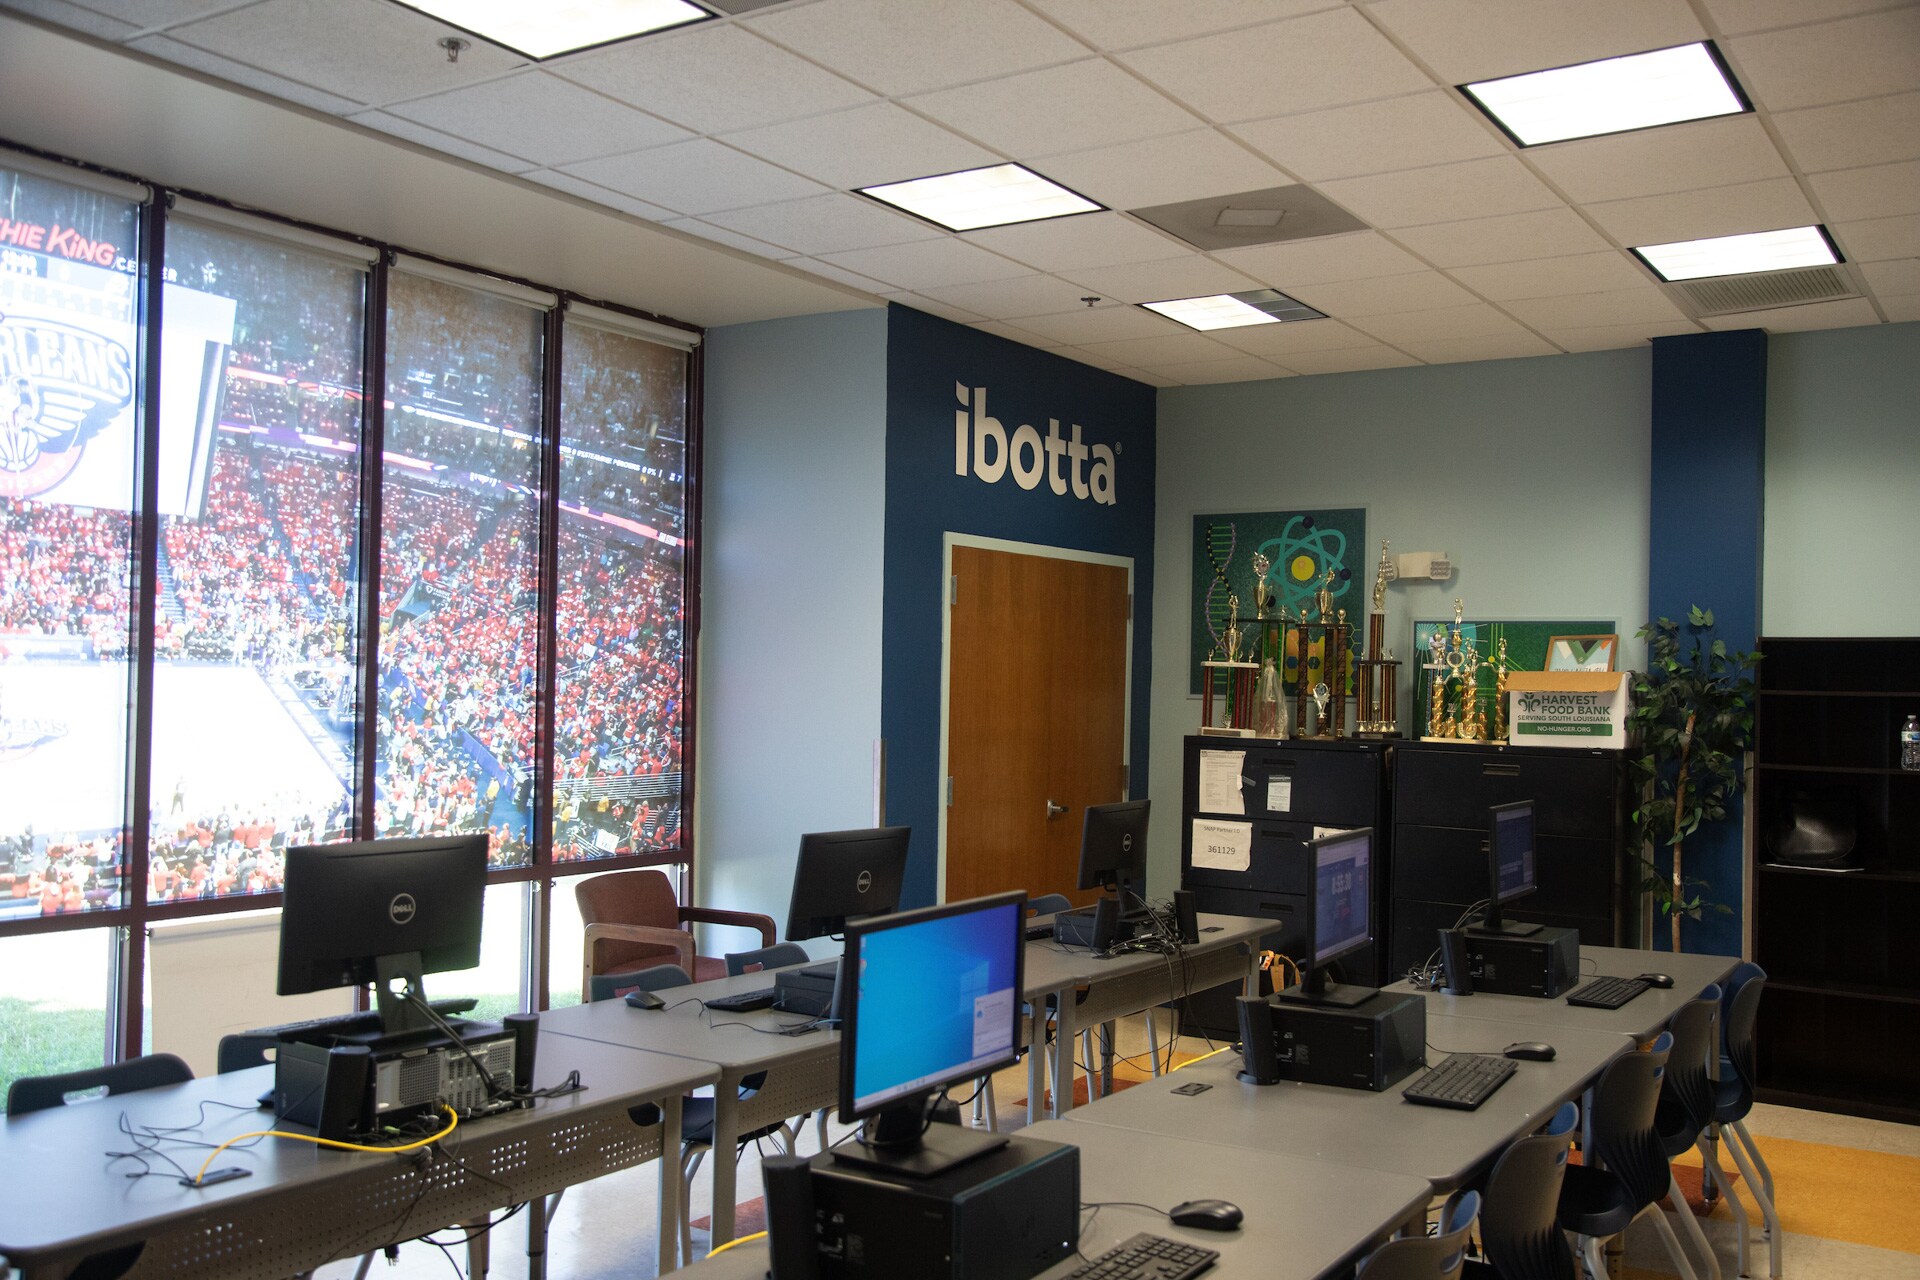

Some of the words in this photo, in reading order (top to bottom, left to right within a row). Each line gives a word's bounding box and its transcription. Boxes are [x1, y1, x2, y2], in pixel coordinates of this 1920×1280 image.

[0, 218, 45, 250] HIE
[1541, 695, 1598, 705] HARVEST
[1541, 705, 1574, 715] FOOD
[1577, 706, 1610, 715] BANK
[1537, 725, 1592, 733] NO-HUNGER.ORG
[1207, 845, 1236, 855] 361129
